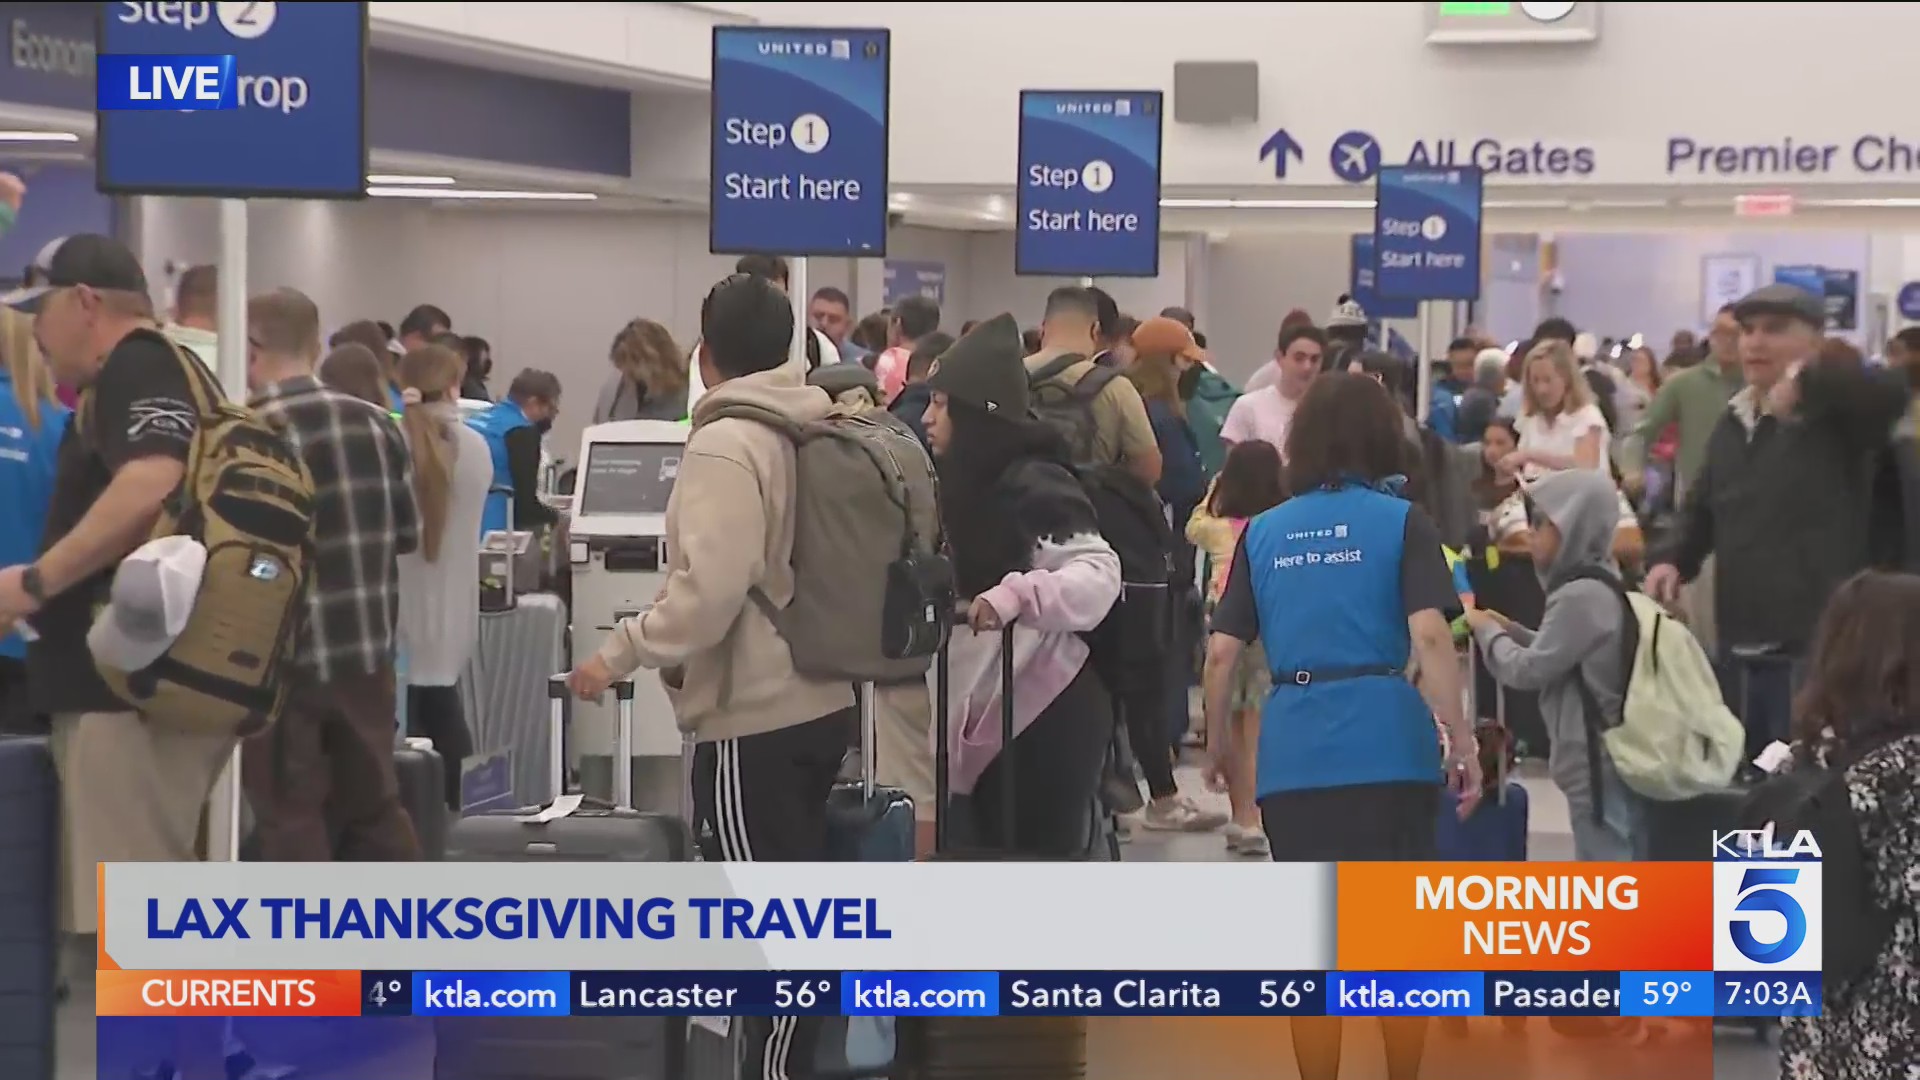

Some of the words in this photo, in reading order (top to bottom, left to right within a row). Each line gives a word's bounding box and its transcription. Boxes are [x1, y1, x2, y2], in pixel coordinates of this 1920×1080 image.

[758, 42, 828, 56] UNITED
[237, 75, 309, 113] rop
[1056, 103, 1113, 114] UNITED
[726, 118, 786, 149] Step
[804, 122, 816, 145] 1
[1471, 138, 1596, 175] Gates
[1667, 136, 1840, 172] Premier
[1852, 135, 1920, 172] Ch
[725, 173, 790, 199] Start
[800, 174, 861, 200] here
[1029, 164, 1079, 189] Step
[1028, 209, 1081, 231] Start
[1087, 209, 1138, 231] here
[1382, 217, 1421, 237] Step
[1381, 250, 1422, 268] Start
[1426, 251, 1465, 268] here
[1286, 529, 1333, 540] UNITED
[1274, 555, 1304, 570] Here
[1306, 552, 1321, 564] to
[1323, 549, 1361, 564] assist
